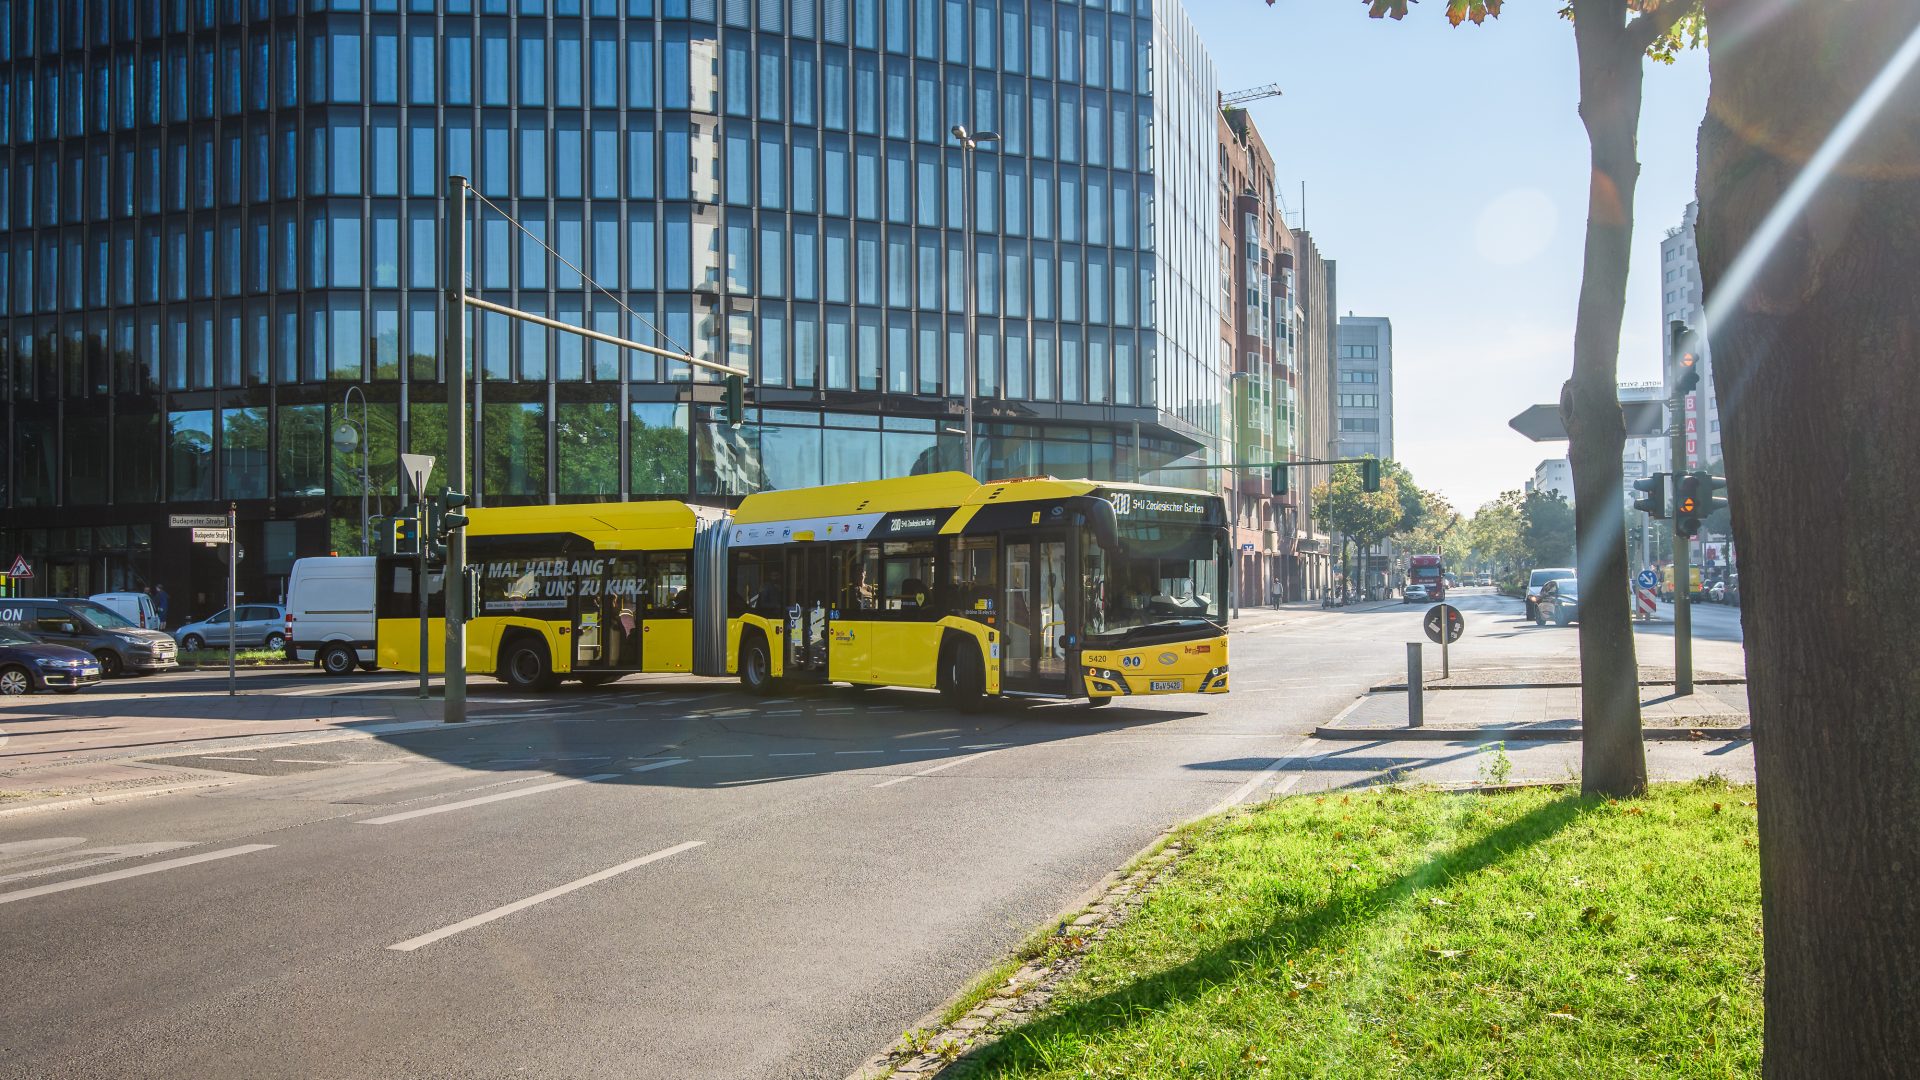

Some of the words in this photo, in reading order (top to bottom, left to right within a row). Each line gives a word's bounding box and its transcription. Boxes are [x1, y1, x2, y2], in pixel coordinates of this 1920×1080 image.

[1110, 492, 1131, 515] 200
[1132, 499, 1145, 510] S+U
[1145, 500, 1183, 512] Zoologischer
[1184, 502, 1204, 514] Garten
[172, 517, 204, 525] Budapester
[205, 517, 225, 525] Straße
[890, 518, 902, 532] 200
[194, 531, 215, 539] Budapester
[488, 562, 519, 578] MAL
[545, 580, 575, 597] UNS
[580, 579, 600, 596] ZU
[605, 578, 649, 596] KURZ.
[0, 608, 24, 621] ON
[1088, 655, 1107, 663] 5420
